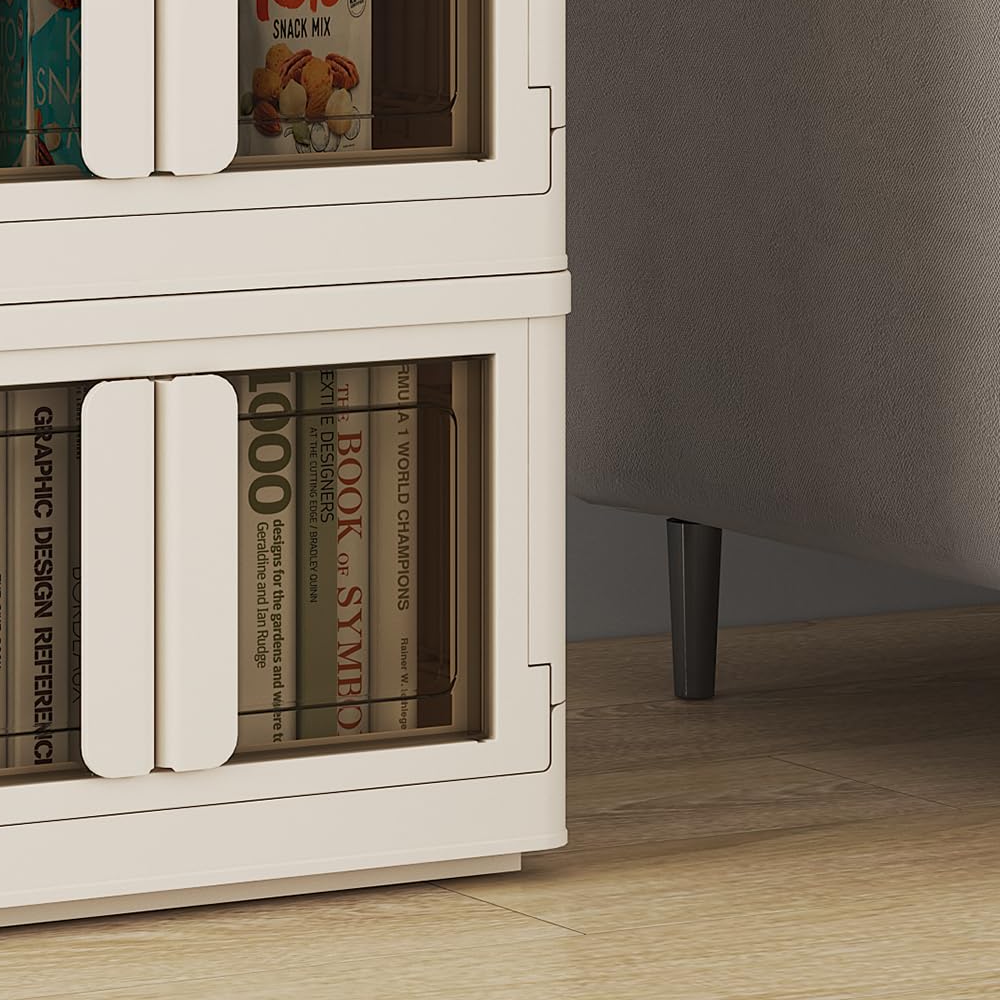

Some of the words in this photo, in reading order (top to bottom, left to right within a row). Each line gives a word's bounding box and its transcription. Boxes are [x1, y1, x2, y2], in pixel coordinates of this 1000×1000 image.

[273, 19, 307, 39] SNACK
[311, 17, 331, 37] MIX
[320, 370, 335, 425] EXTIE
[397, 363, 410, 423] RMUA
[248, 372, 292, 514] 1000
[309, 427, 318, 437] AT
[309, 441, 318, 457] THE
[34, 406, 53, 519] GRAPHIC
[309, 461, 318, 498] CUTTING
[320, 431, 335, 523] DESIGNERS
[397, 442, 410, 504] WORLD
[337, 431, 362, 544] BOOK
[309, 500, 318, 523] EDGE
[256, 521, 269, 580] Geraldine
[270, 519, 285, 567] designs
[309, 531, 318, 572] BRADLEY
[397, 508, 410, 611] CHAMPIONS
[34, 526, 53, 618] DESIGN
[273, 569, 285, 588] for
[337, 553, 349, 576] OF
[256, 582, 269, 605] and
[273, 590, 285, 611] the
[309, 574, 318, 602] QUINN
[256, 608, 269, 628] Ian
[254, 630, 269, 668] Rudge
[270, 613, 285, 663] gardens
[400, 637, 409, 670] Rainer
[272, 665, 285, 689] and
[337, 586, 362, 735] SYMBO
[400, 673, 409, 687] W.
